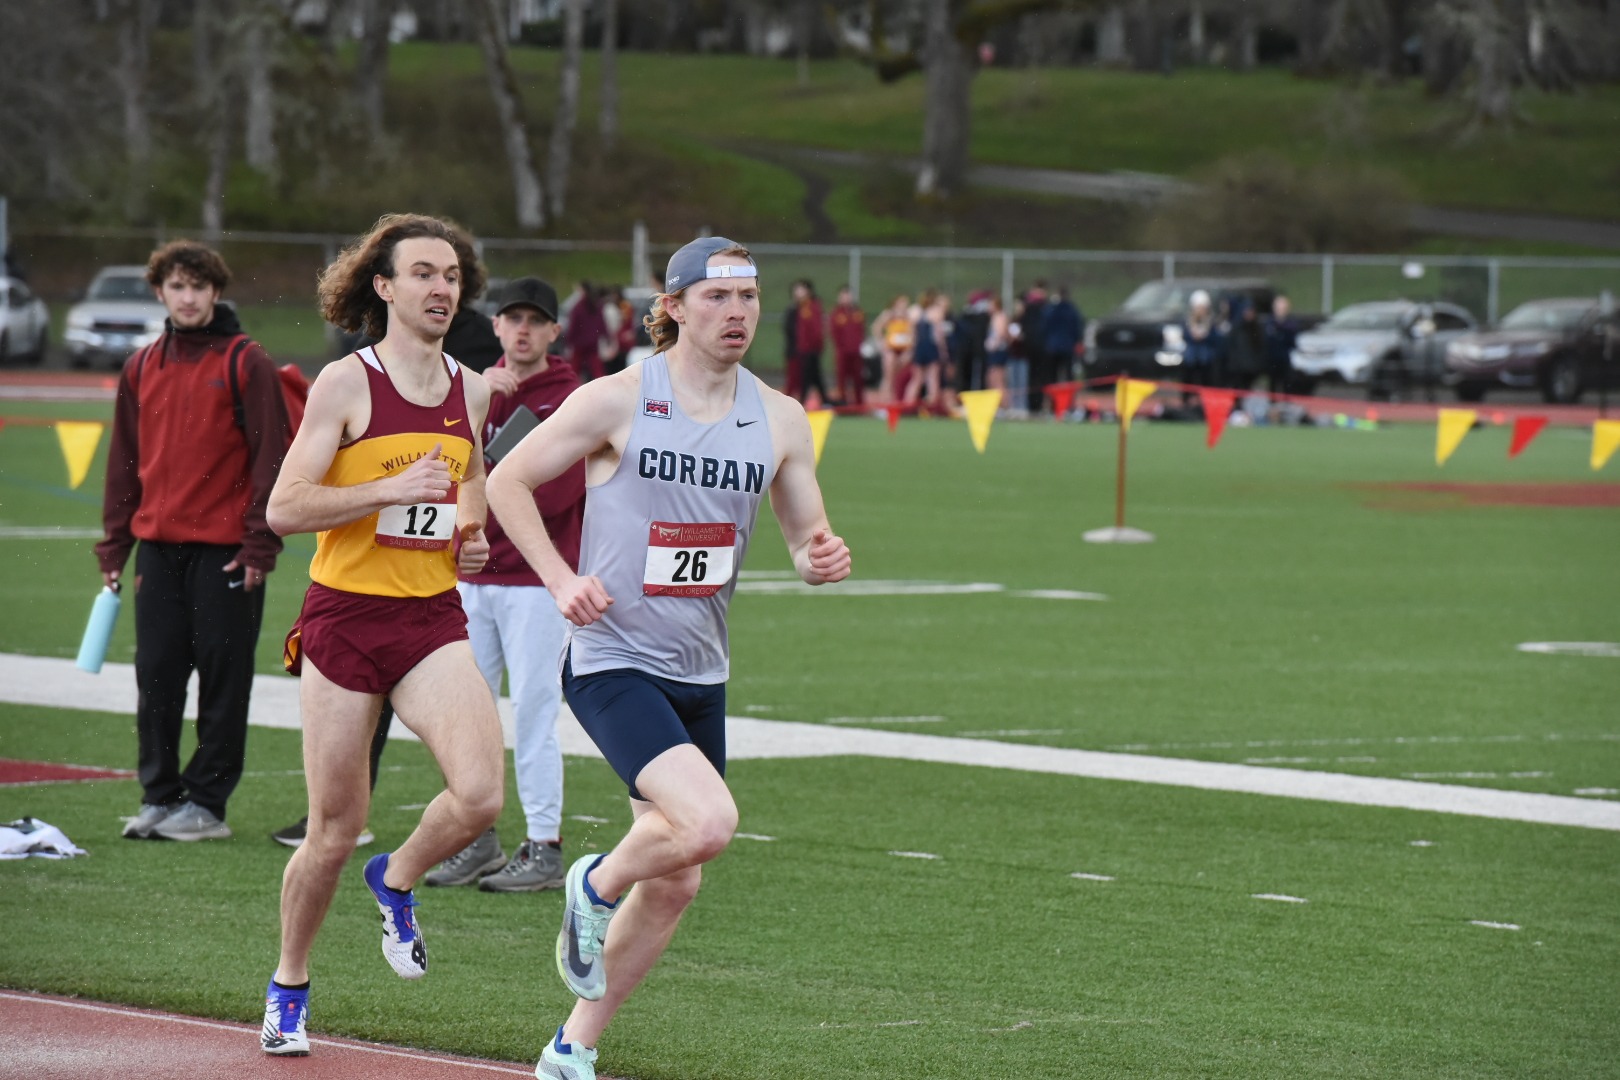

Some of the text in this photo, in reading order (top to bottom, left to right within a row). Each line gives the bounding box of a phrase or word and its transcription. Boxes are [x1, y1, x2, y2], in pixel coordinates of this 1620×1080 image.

[381, 451, 462, 474] WILLATTE
[638, 447, 766, 495] CORBAN
[403, 505, 438, 536] 12
[683, 526, 726, 535] WILLAMETTE
[683, 534, 722, 542] UNIVERSITY
[671, 550, 709, 583] 26
[685, 587, 717, 595] OREGON
